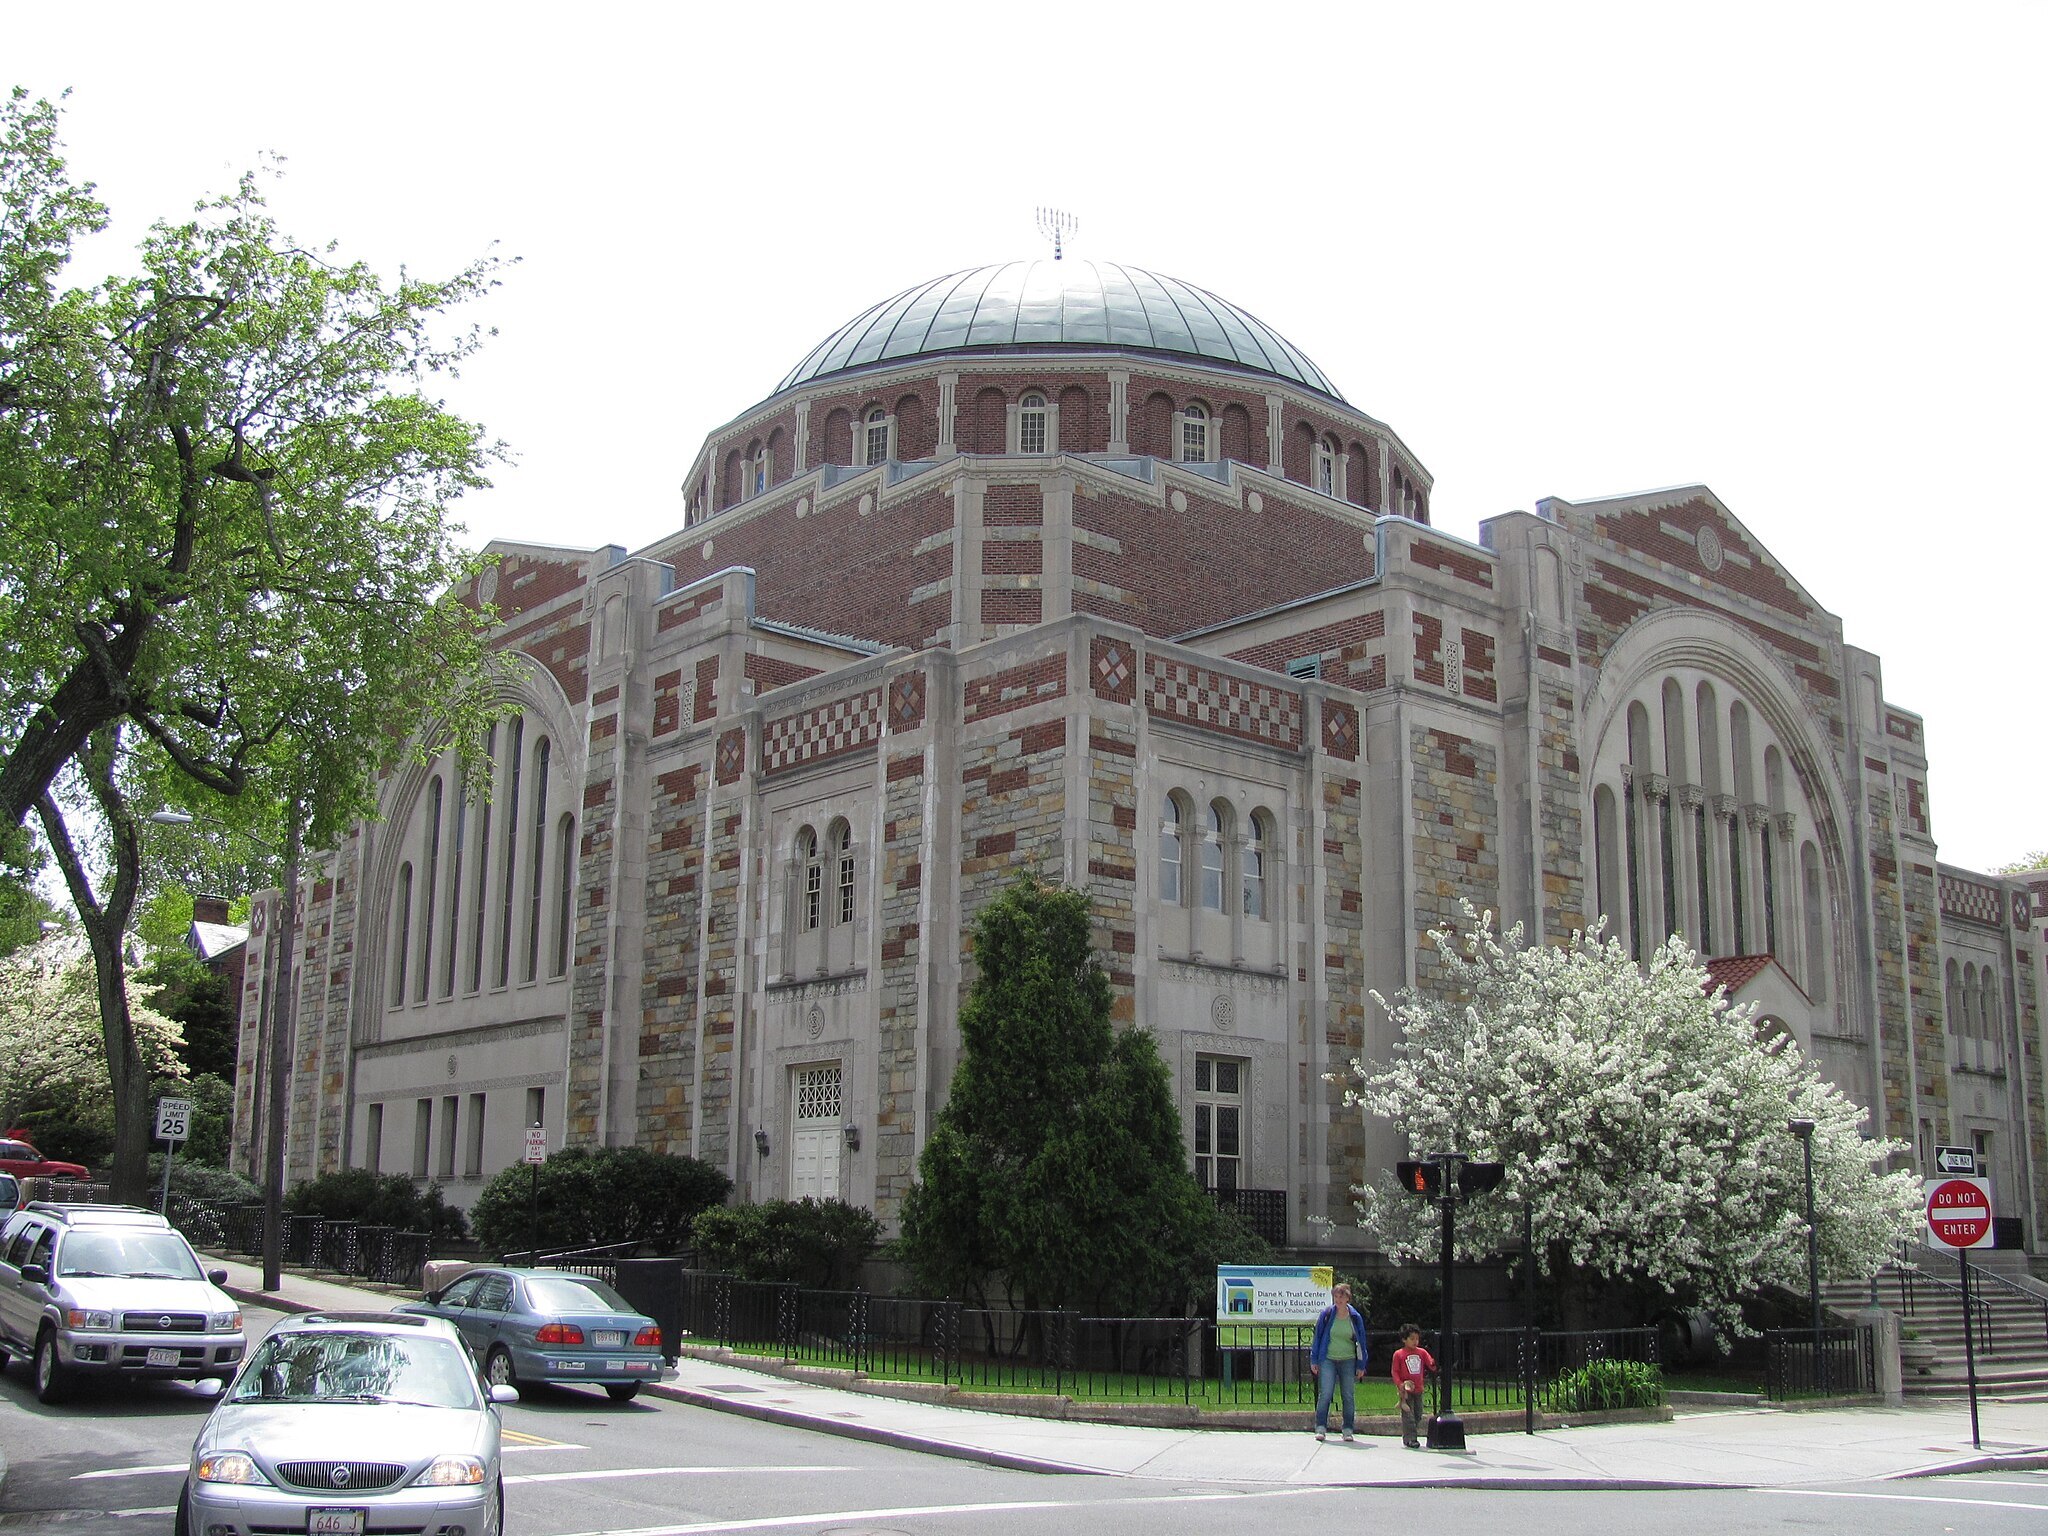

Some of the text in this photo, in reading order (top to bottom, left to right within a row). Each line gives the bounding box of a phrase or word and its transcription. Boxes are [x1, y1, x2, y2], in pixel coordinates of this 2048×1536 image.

[162, 1102, 190, 1110] SPEED
[161, 1119, 184, 1135] 25
[1947, 1155, 1971, 1167] ONE WAY
[1938, 1192, 1976, 1204] DO NOT
[1943, 1223, 1977, 1235] ENTER
[1257, 1290, 1277, 1298] Diane
[1286, 1290, 1303, 1298] Trust
[1269, 1299, 1288, 1307] Early
[1289, 1299, 1326, 1307] Education
[317, 1516, 357, 1530] 646 J
